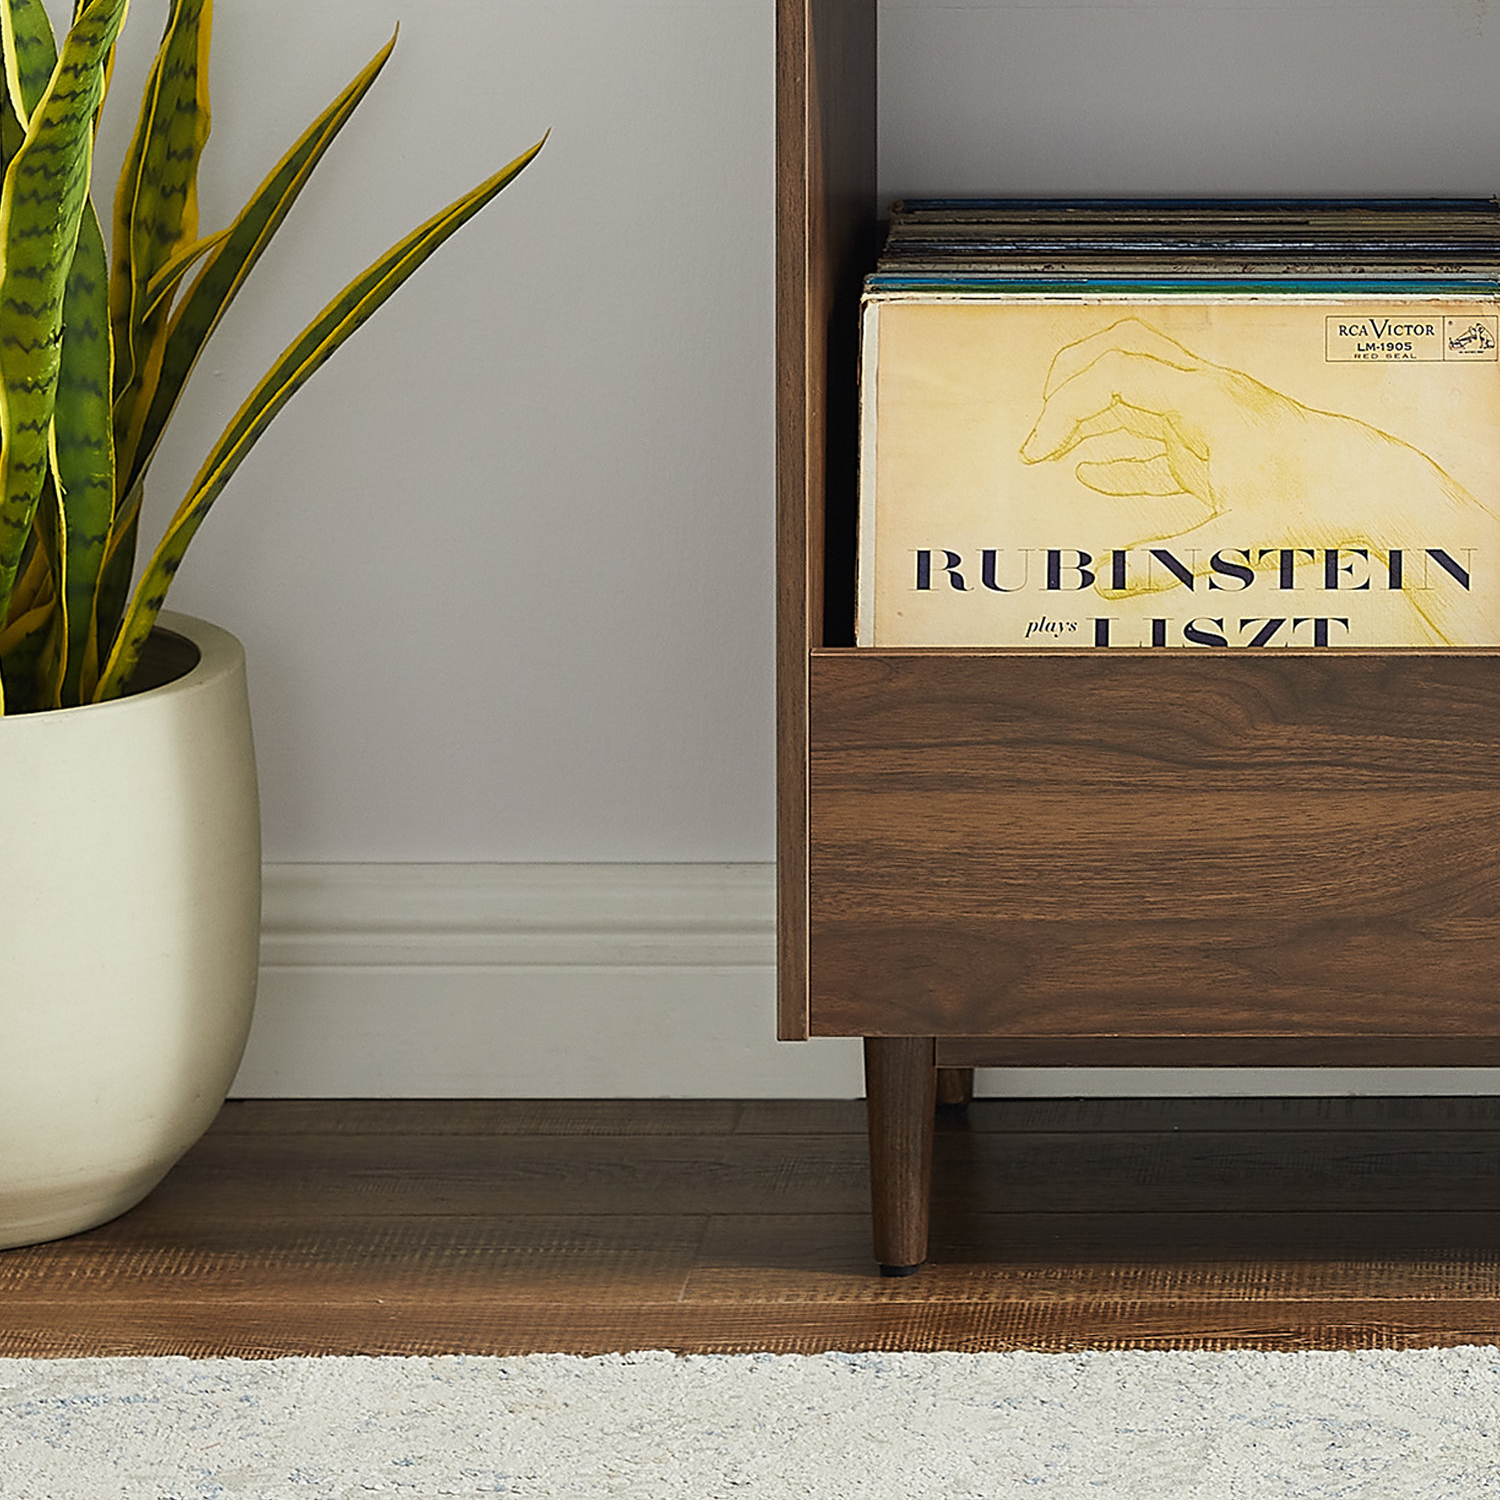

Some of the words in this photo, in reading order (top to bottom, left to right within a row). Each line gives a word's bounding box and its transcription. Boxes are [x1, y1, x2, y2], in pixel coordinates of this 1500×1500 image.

[1339, 325, 1368, 336] RCA
[1357, 342, 1412, 351] LM-1905
[907, 548, 1475, 591] RUBINSTEIN
[1025, 616, 1077, 638] plays
[1086, 617, 1350, 647] LISZT
